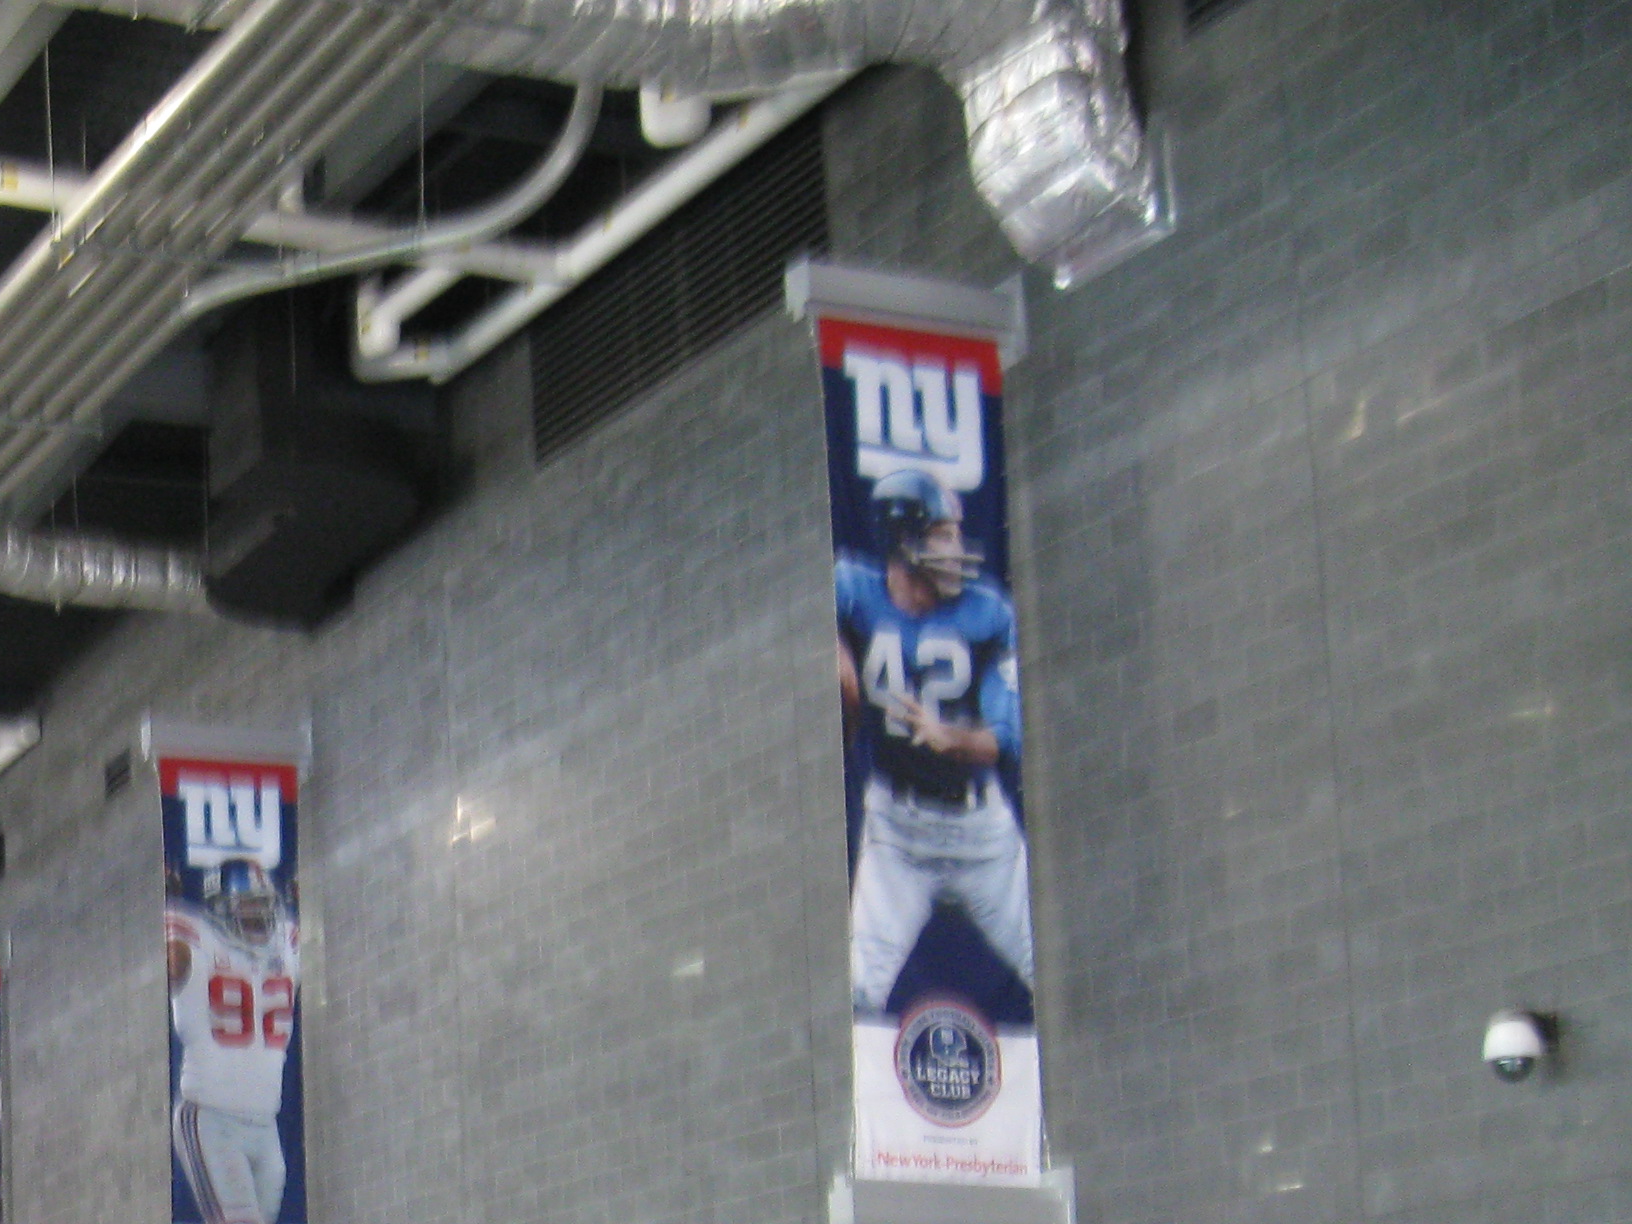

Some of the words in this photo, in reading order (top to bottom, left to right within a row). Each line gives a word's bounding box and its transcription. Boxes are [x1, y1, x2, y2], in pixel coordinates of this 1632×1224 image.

[864, 630, 971, 737] 42
[208, 974, 294, 1049] 92
[915, 1064, 980, 1085] LEGACY
[930, 1082, 972, 1100] CLUB
